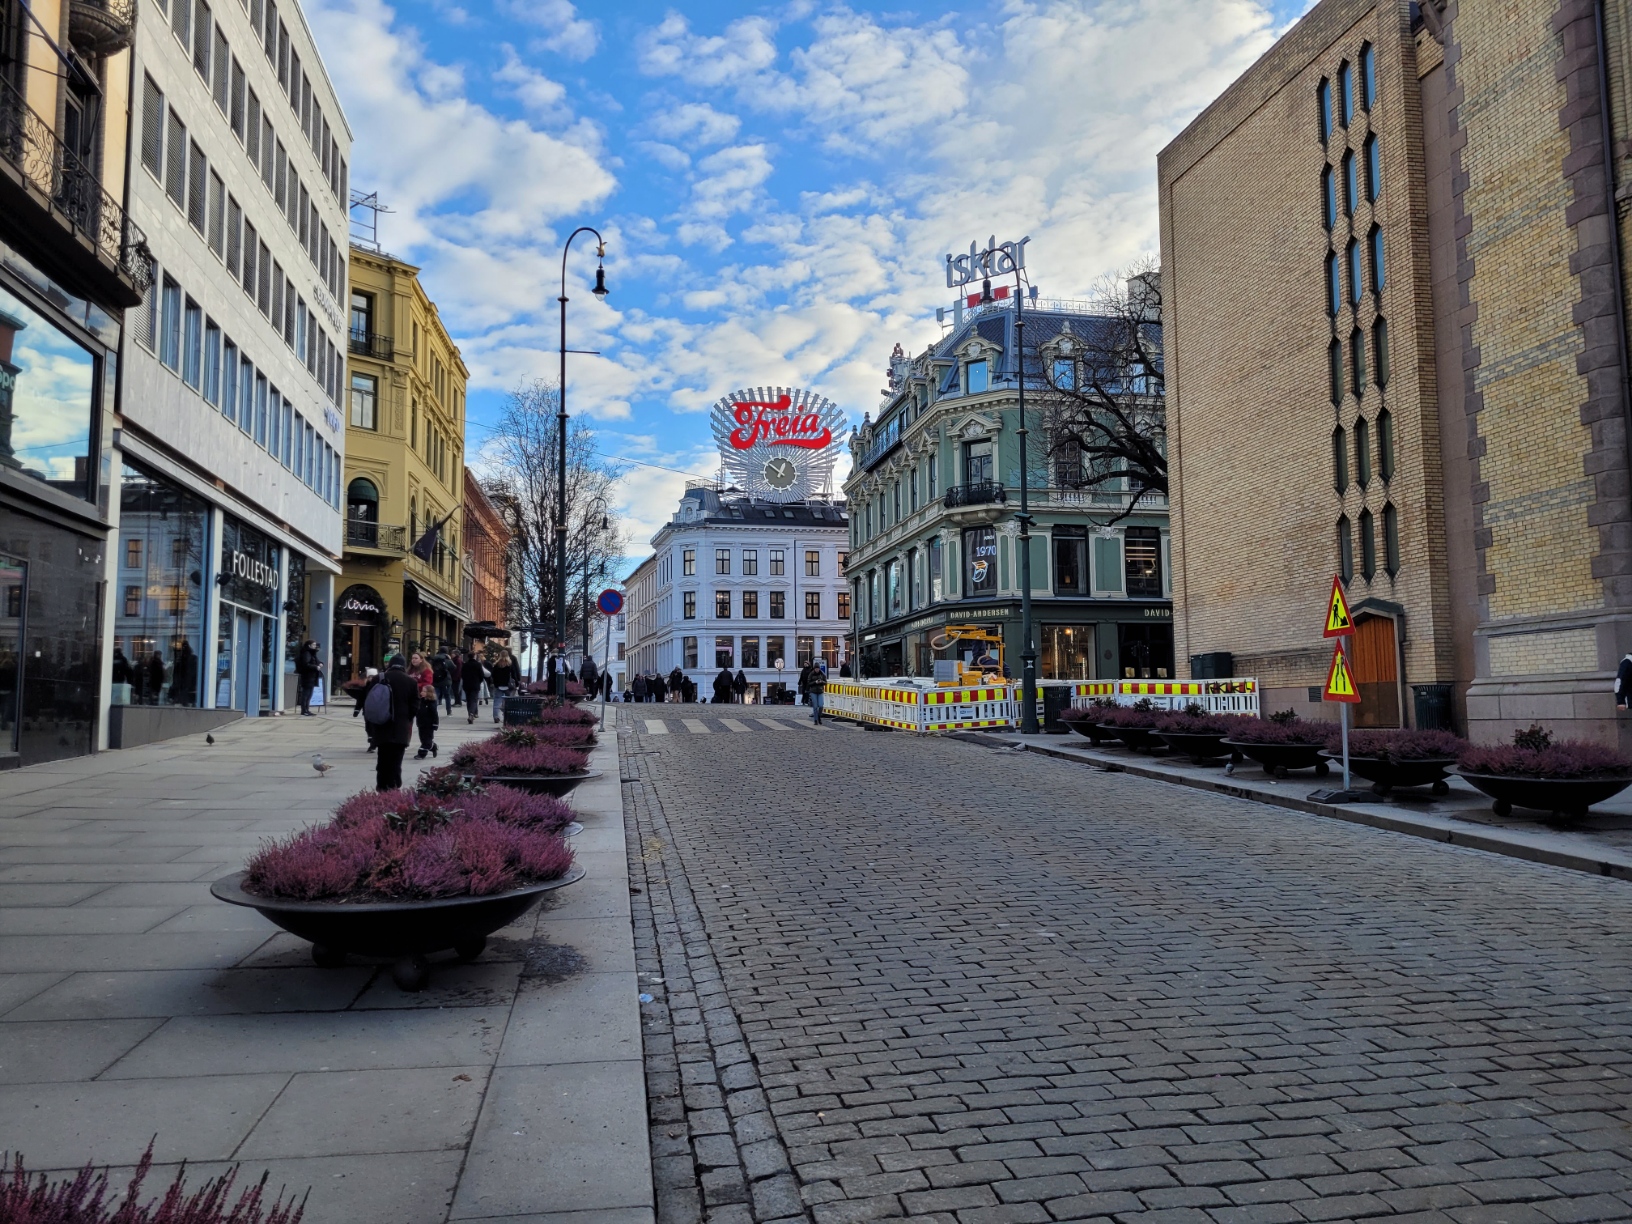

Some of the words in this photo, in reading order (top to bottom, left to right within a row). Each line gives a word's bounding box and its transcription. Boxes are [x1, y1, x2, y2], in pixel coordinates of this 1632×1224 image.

[946, 234, 1031, 288] isklar
[729, 394, 832, 450] Freia
[233, 550, 279, 591] FOLLESTAD
[976, 544, 996, 557] 1970
[950, 608, 1009, 619] DAVID-ANDERSEN
